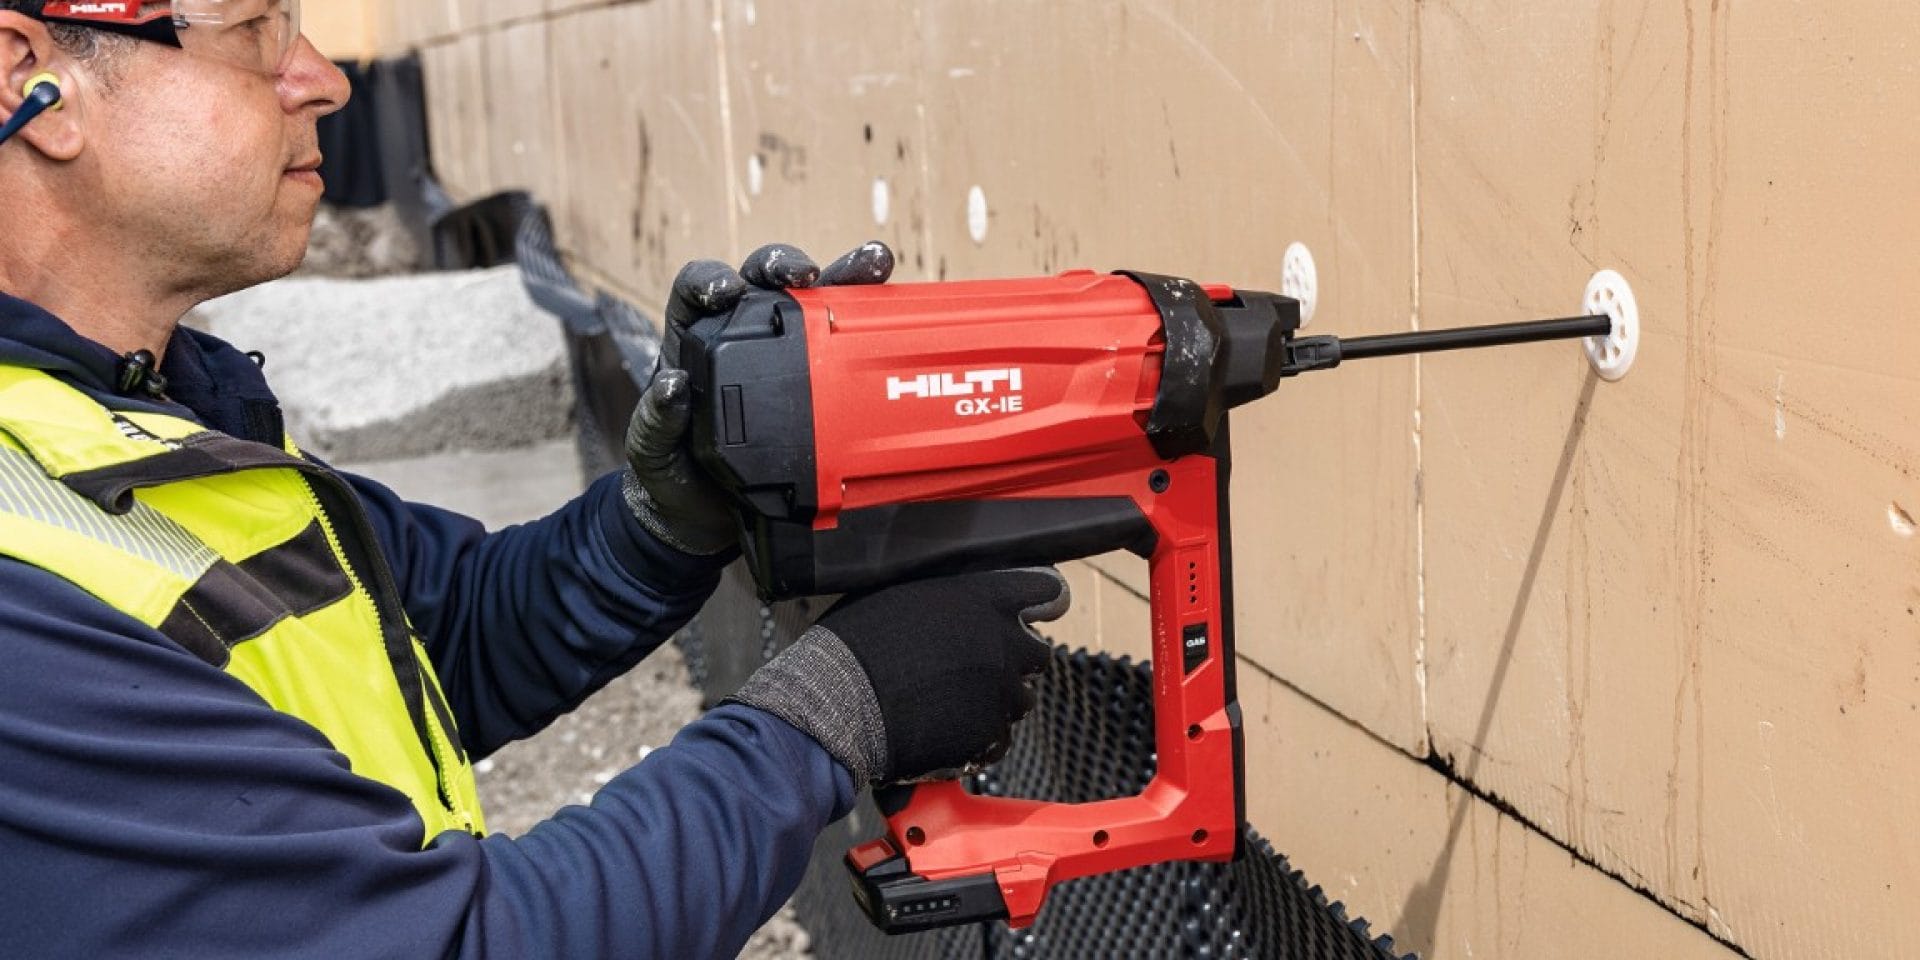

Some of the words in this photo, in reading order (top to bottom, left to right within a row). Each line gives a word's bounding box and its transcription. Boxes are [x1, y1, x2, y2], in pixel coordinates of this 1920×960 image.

[70, 3, 126, 13] HILTI
[887, 368, 1022, 400] HILTI
[955, 396, 1023, 415] GX-IE
[1186, 637, 1205, 647] GAS
